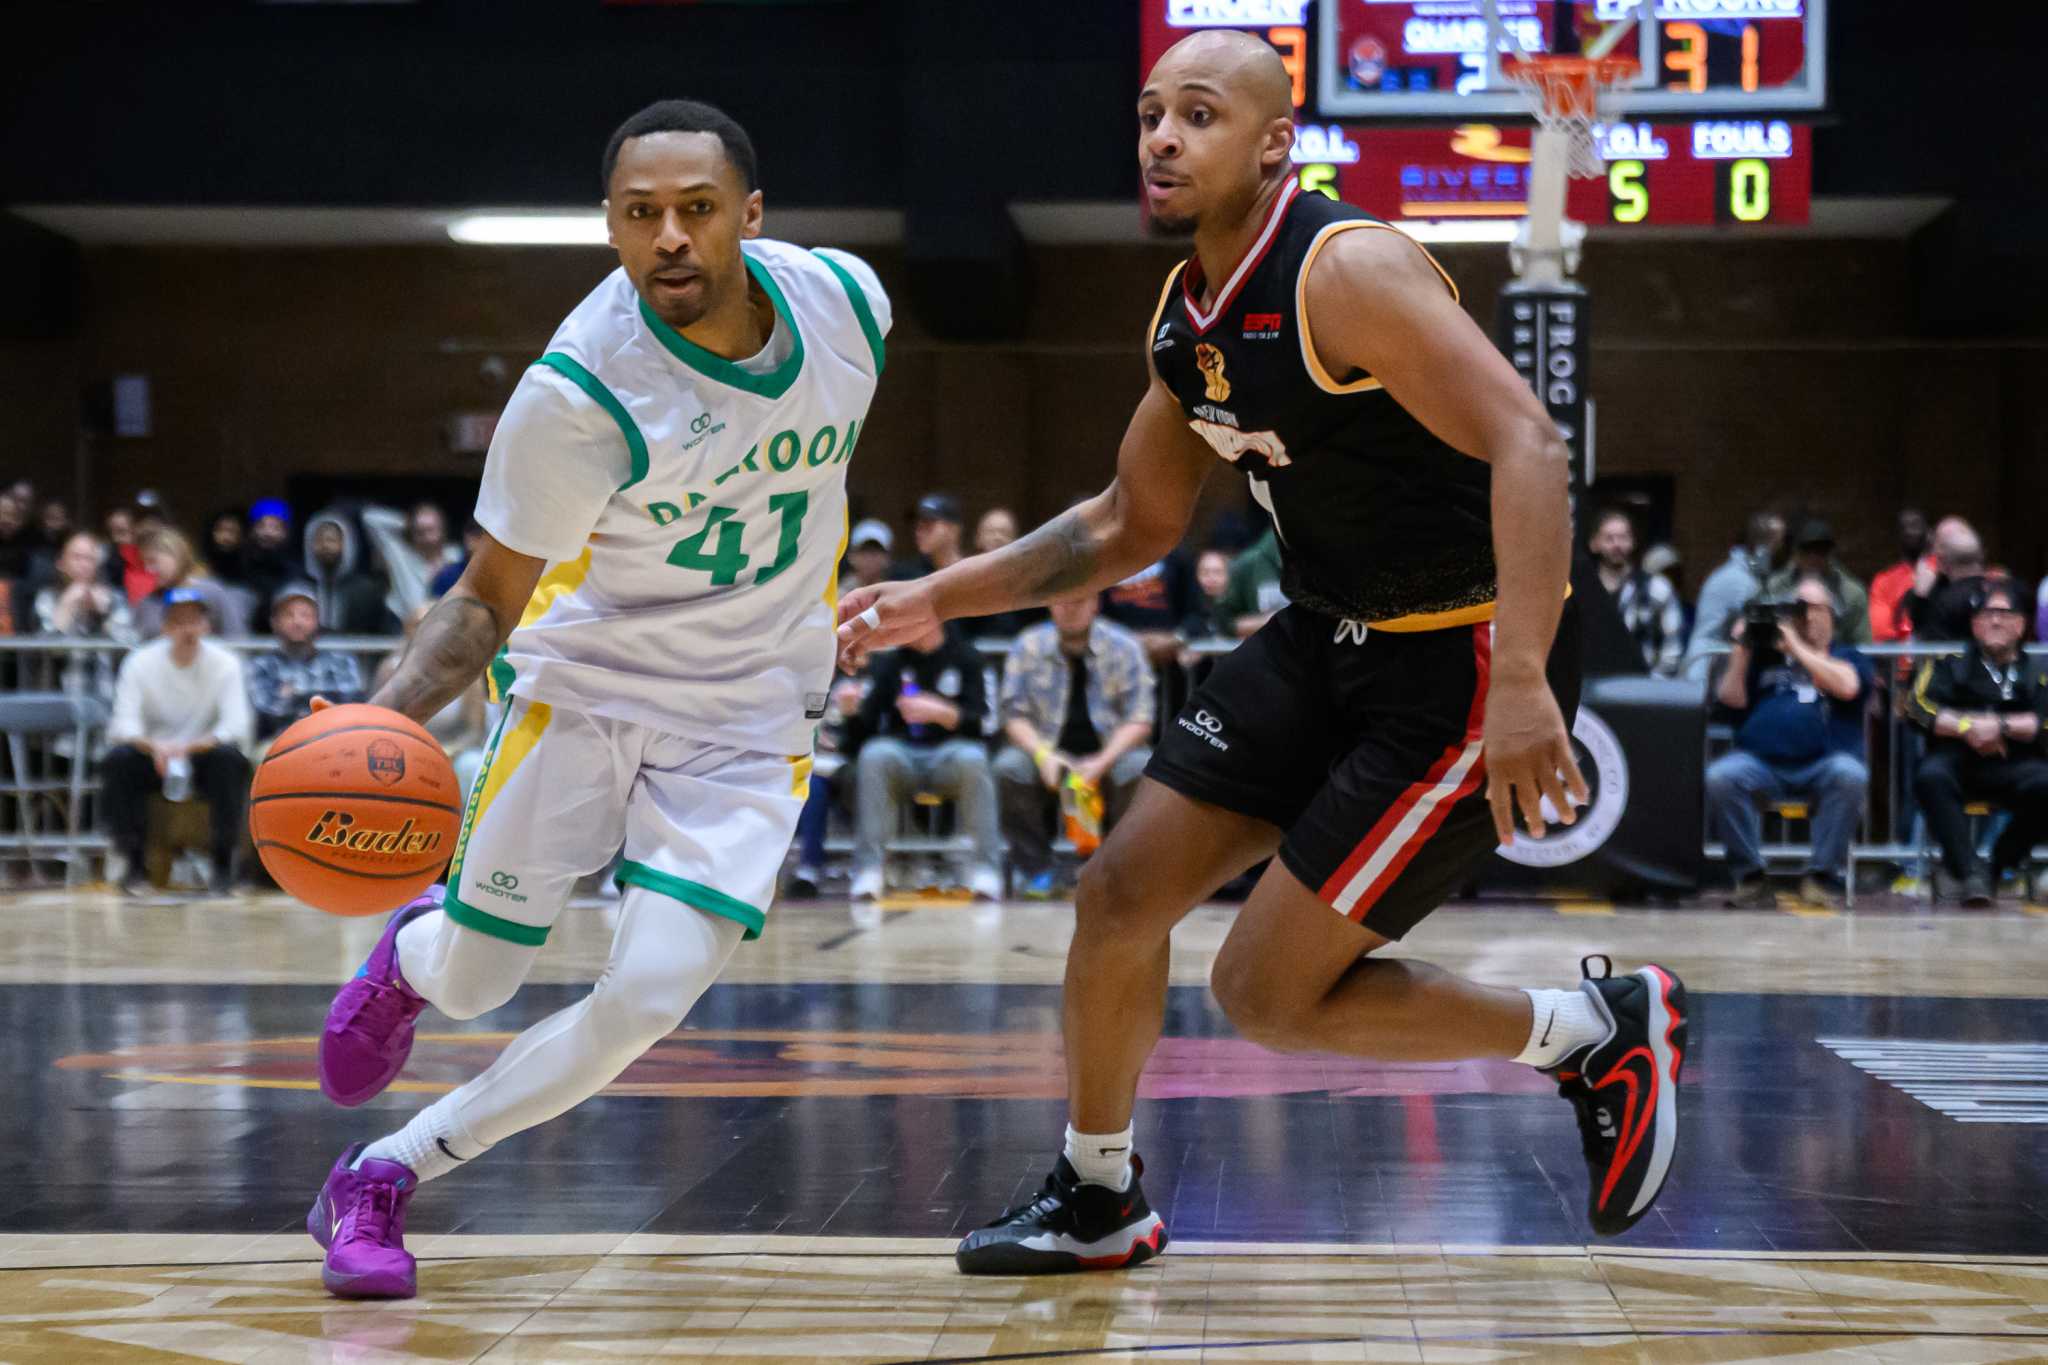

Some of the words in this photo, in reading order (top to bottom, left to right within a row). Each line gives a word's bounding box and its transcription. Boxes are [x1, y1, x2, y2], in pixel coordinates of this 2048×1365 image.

[1404, 17, 1542, 51] QUARR
[1665, 21, 1759, 94] 31
[1692, 121, 1792, 156] FOULS
[1609, 159, 1649, 222] 5
[1730, 158, 1770, 221] 0
[1178, 717, 1228, 752] WOOTER
[305, 809, 443, 853] Baden
[475, 880, 527, 904] WOOTER
